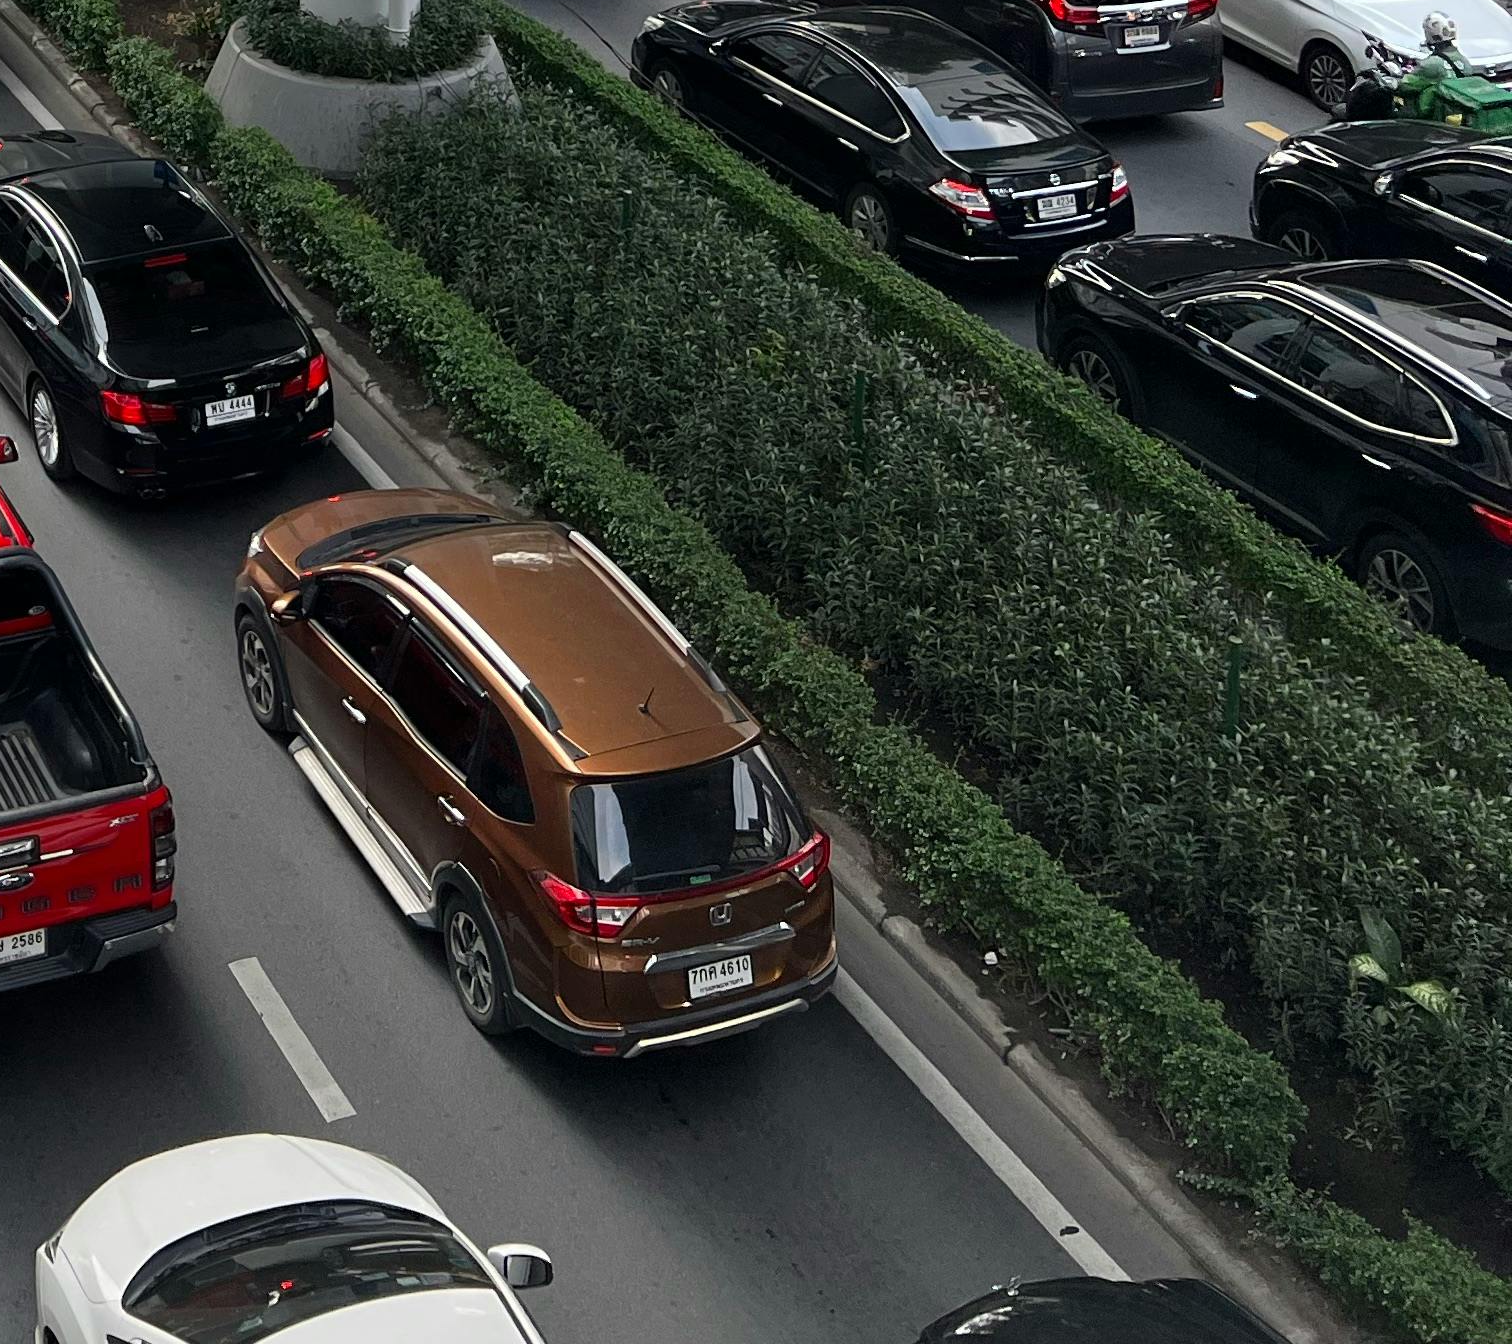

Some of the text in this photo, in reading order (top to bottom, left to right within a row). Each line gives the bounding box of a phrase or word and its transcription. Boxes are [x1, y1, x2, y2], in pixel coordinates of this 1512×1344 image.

[229, 396, 252, 410] 4444
[11, 931, 44, 950] 2586
[720, 957, 750, 977] 4610
